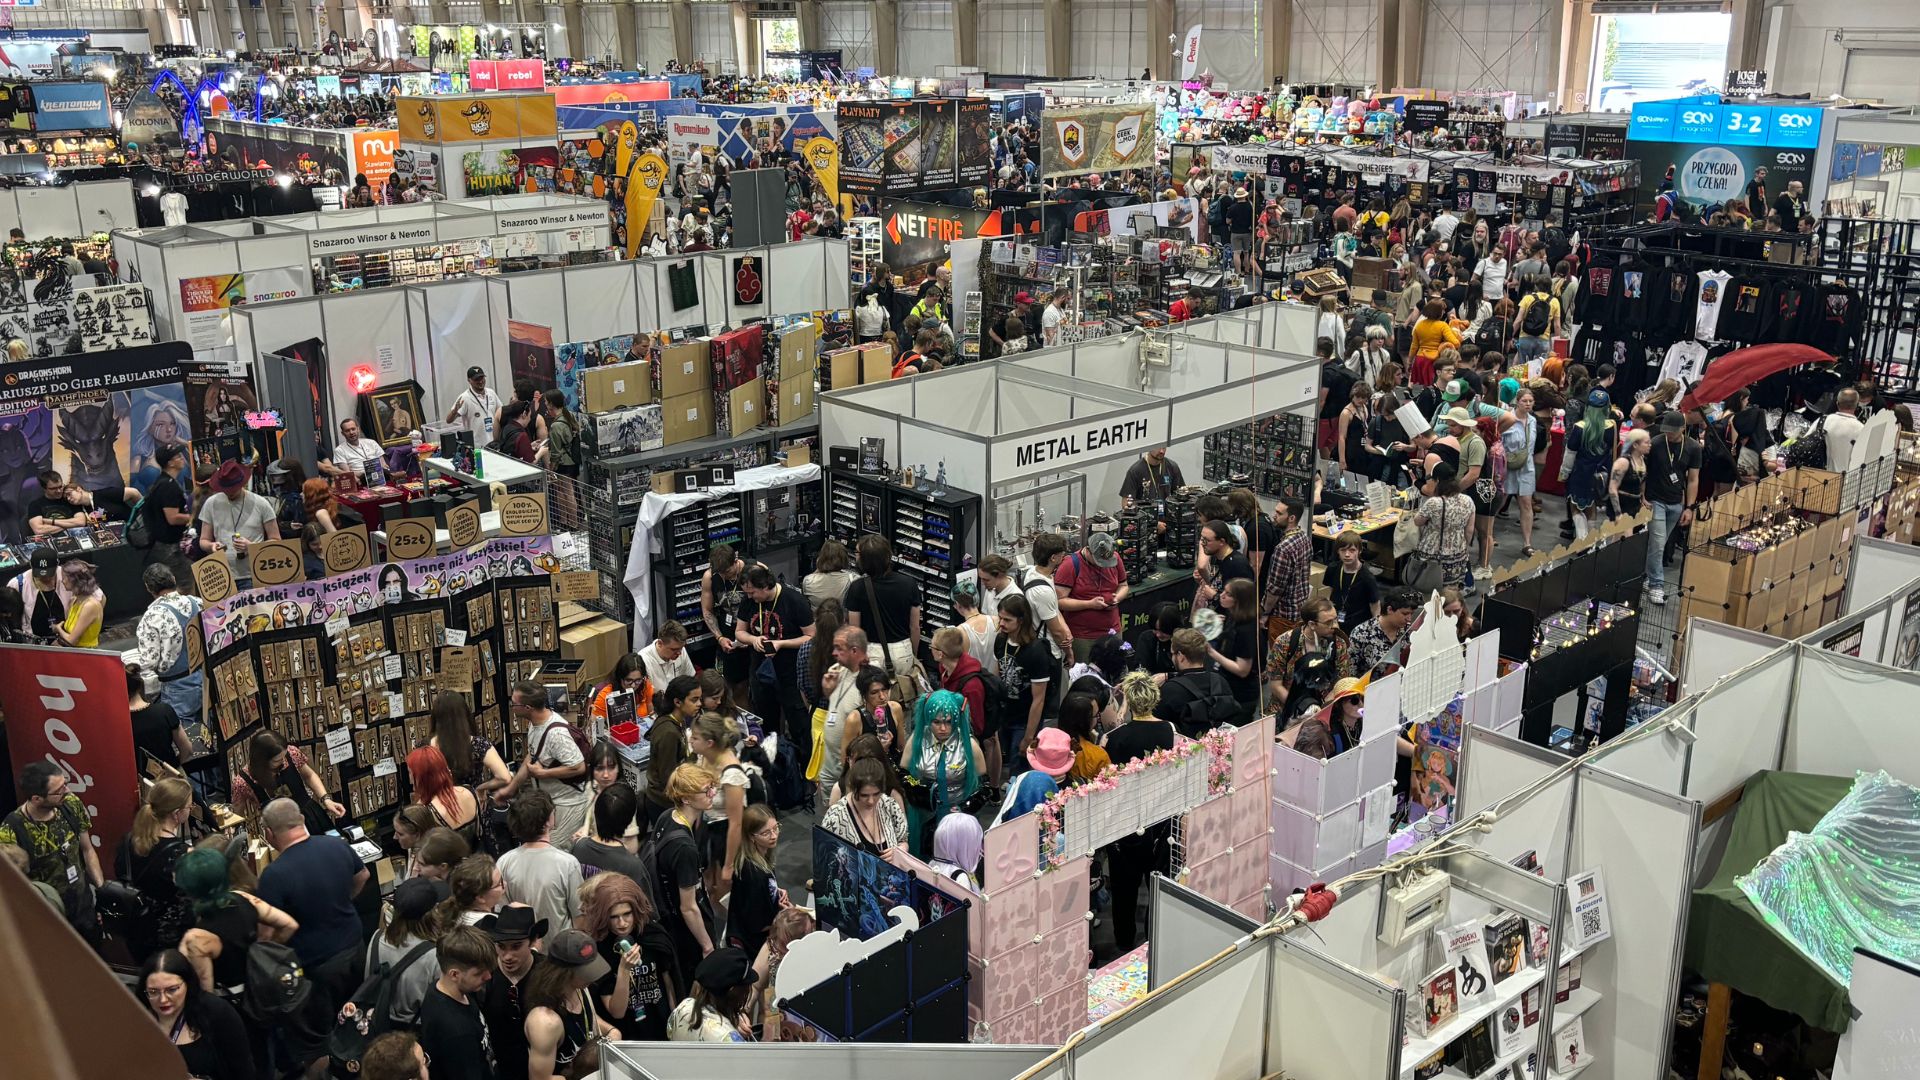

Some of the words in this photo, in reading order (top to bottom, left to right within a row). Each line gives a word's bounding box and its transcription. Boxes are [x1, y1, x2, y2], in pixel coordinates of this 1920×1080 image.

[507, 70, 533, 80] rebel
[839, 106, 881, 118] PLAYMATY
[129, 117, 170, 127] KOLONIA
[1727, 112, 1742, 131] 3
[1749, 116, 1762, 133] 2
[1357, 162, 1393, 173] OTHERTEES
[1691, 161, 1737, 176] PRZYGODA
[188, 168, 276, 183] UNDERWORLD
[470, 173, 512, 190] HUTAN
[1697, 178, 1728, 190] CZEKA!
[501, 218, 539, 228] Snazaroo
[540, 216, 567, 225] Winsor
[577, 212, 605, 220] Newton
[897, 212, 963, 241] NETFIRE
[312, 236, 355, 249] Snazaroo
[357, 233, 388, 244] Winsor
[391, 231, 397, 240] &
[398, 228, 431, 240] Newton
[253, 290, 296, 302] snazaroo
[1016, 436, 1080, 468] METAL
[1086, 418, 1147, 451] EARTH
[394, 534, 426, 546] 25zł
[259, 556, 293, 571] 25zł
[230, 588, 289, 613] Zakładki
[296, 578, 316, 598] do
[323, 564, 372, 594] książek
[414, 562, 445, 575] inne
[449, 554, 464, 572] niż
[465, 539, 526, 563] wszystkie!
[1458, 954, 1487, 998] あ
